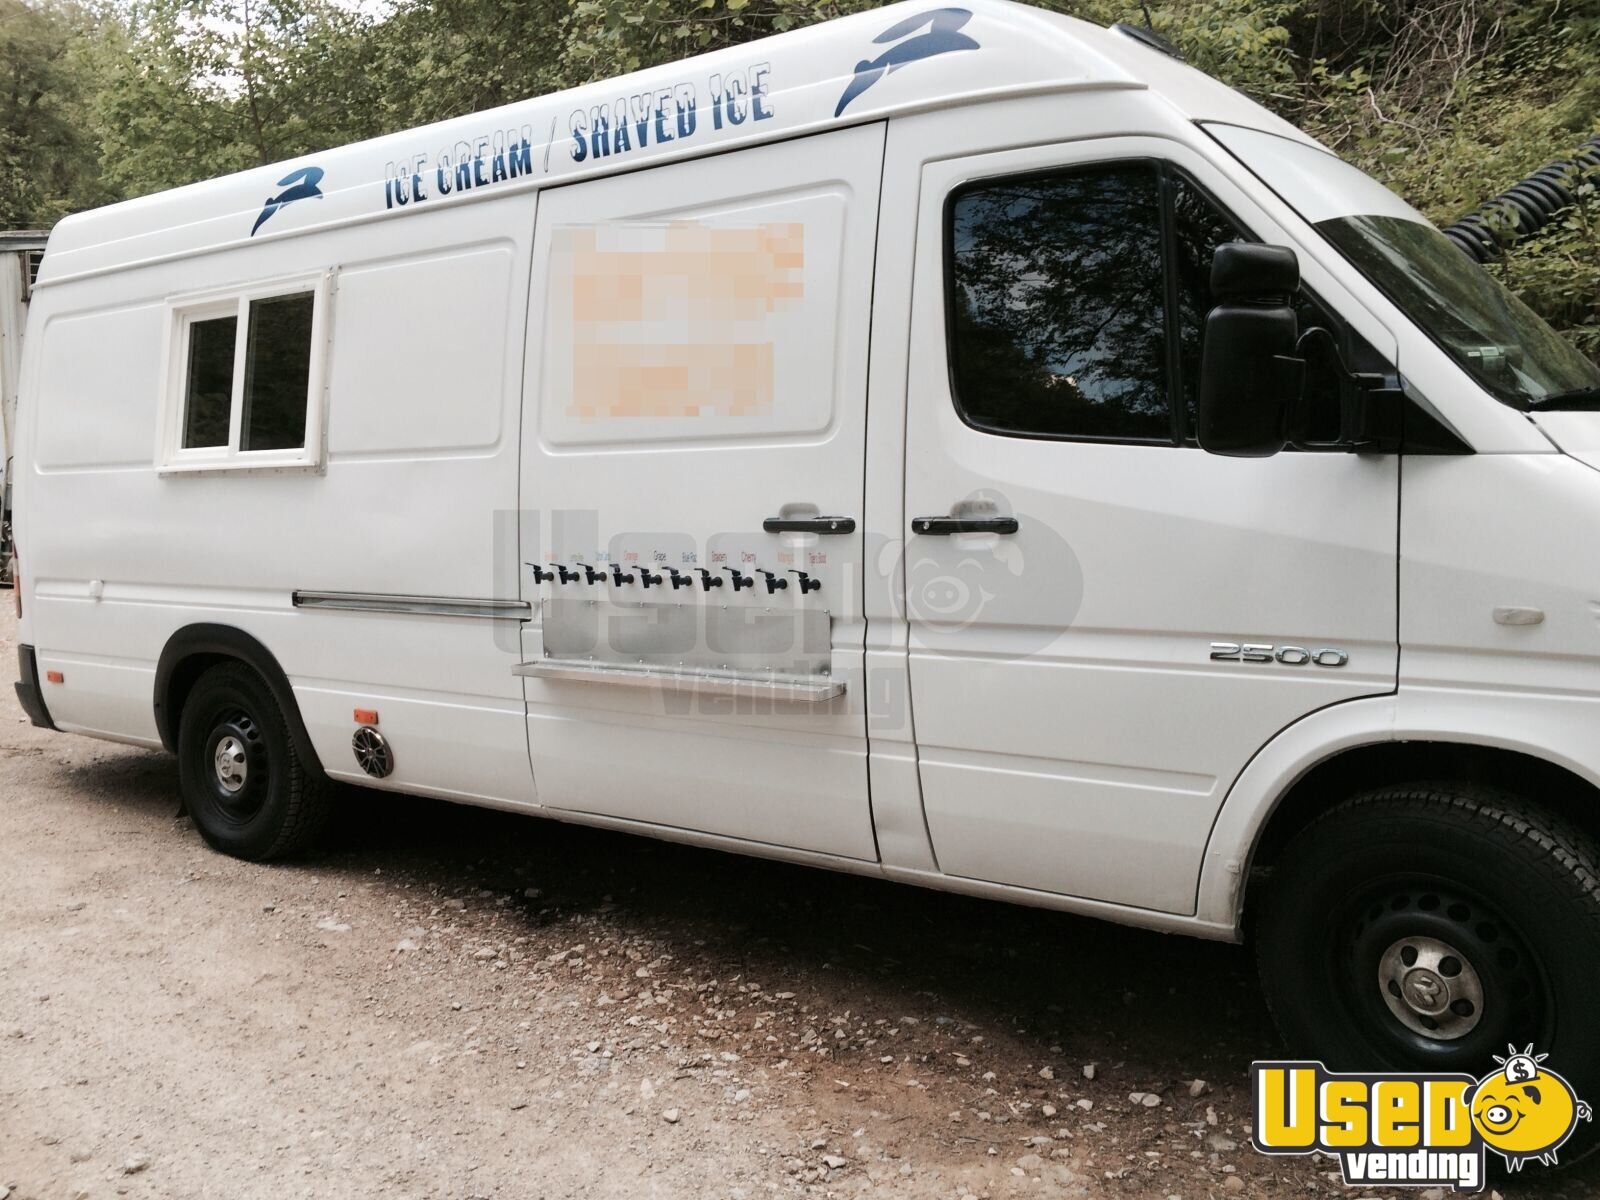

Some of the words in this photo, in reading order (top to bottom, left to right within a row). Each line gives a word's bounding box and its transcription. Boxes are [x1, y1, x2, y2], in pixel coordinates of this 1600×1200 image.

[385, 154, 428, 209] ICE
[437, 124, 532, 195] CREAM
[569, 83, 696, 163] SHAVED
[709, 62, 775, 130] ICE
[1210, 642, 1349, 667] 2500
